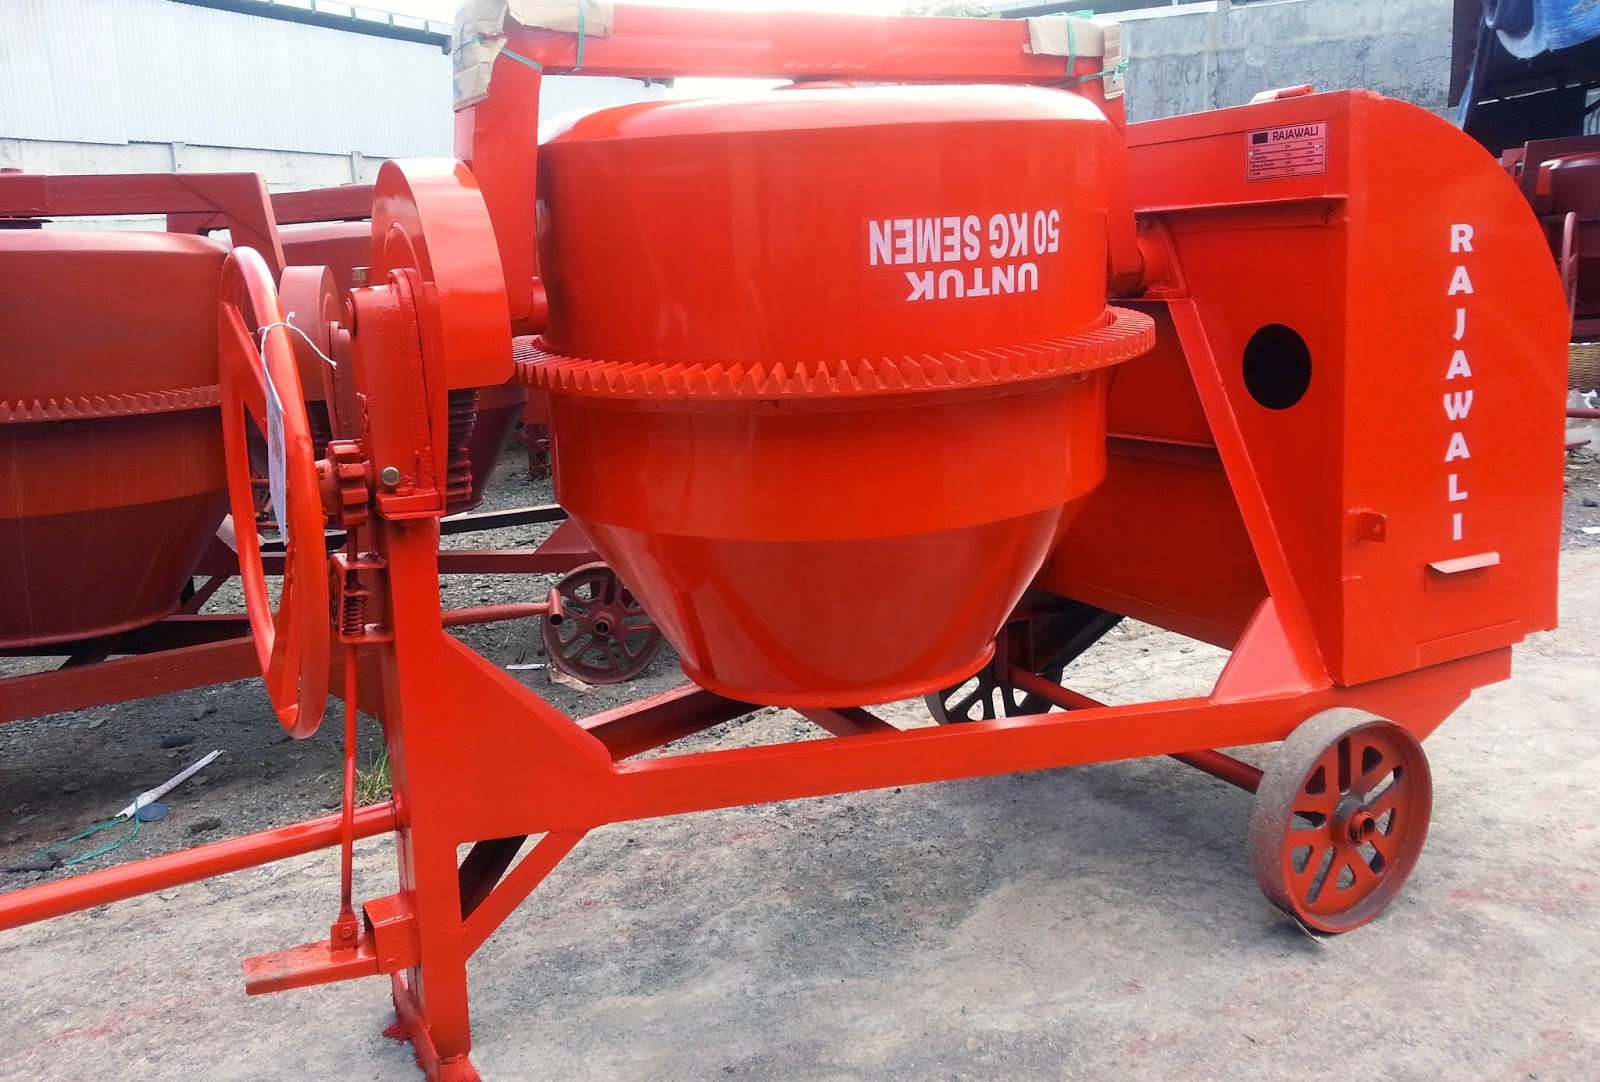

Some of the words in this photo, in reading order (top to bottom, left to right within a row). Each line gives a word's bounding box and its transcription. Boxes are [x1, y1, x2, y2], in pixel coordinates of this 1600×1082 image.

[1273, 126, 1318, 140] RAJAWALI
[869, 215, 981, 266] SEMEN
[988, 212, 1028, 259] KG
[1033, 209, 1060, 255] 50
[904, 262, 1038, 302] UNTUK
[1443, 223, 1474, 541] RAJAWALI
